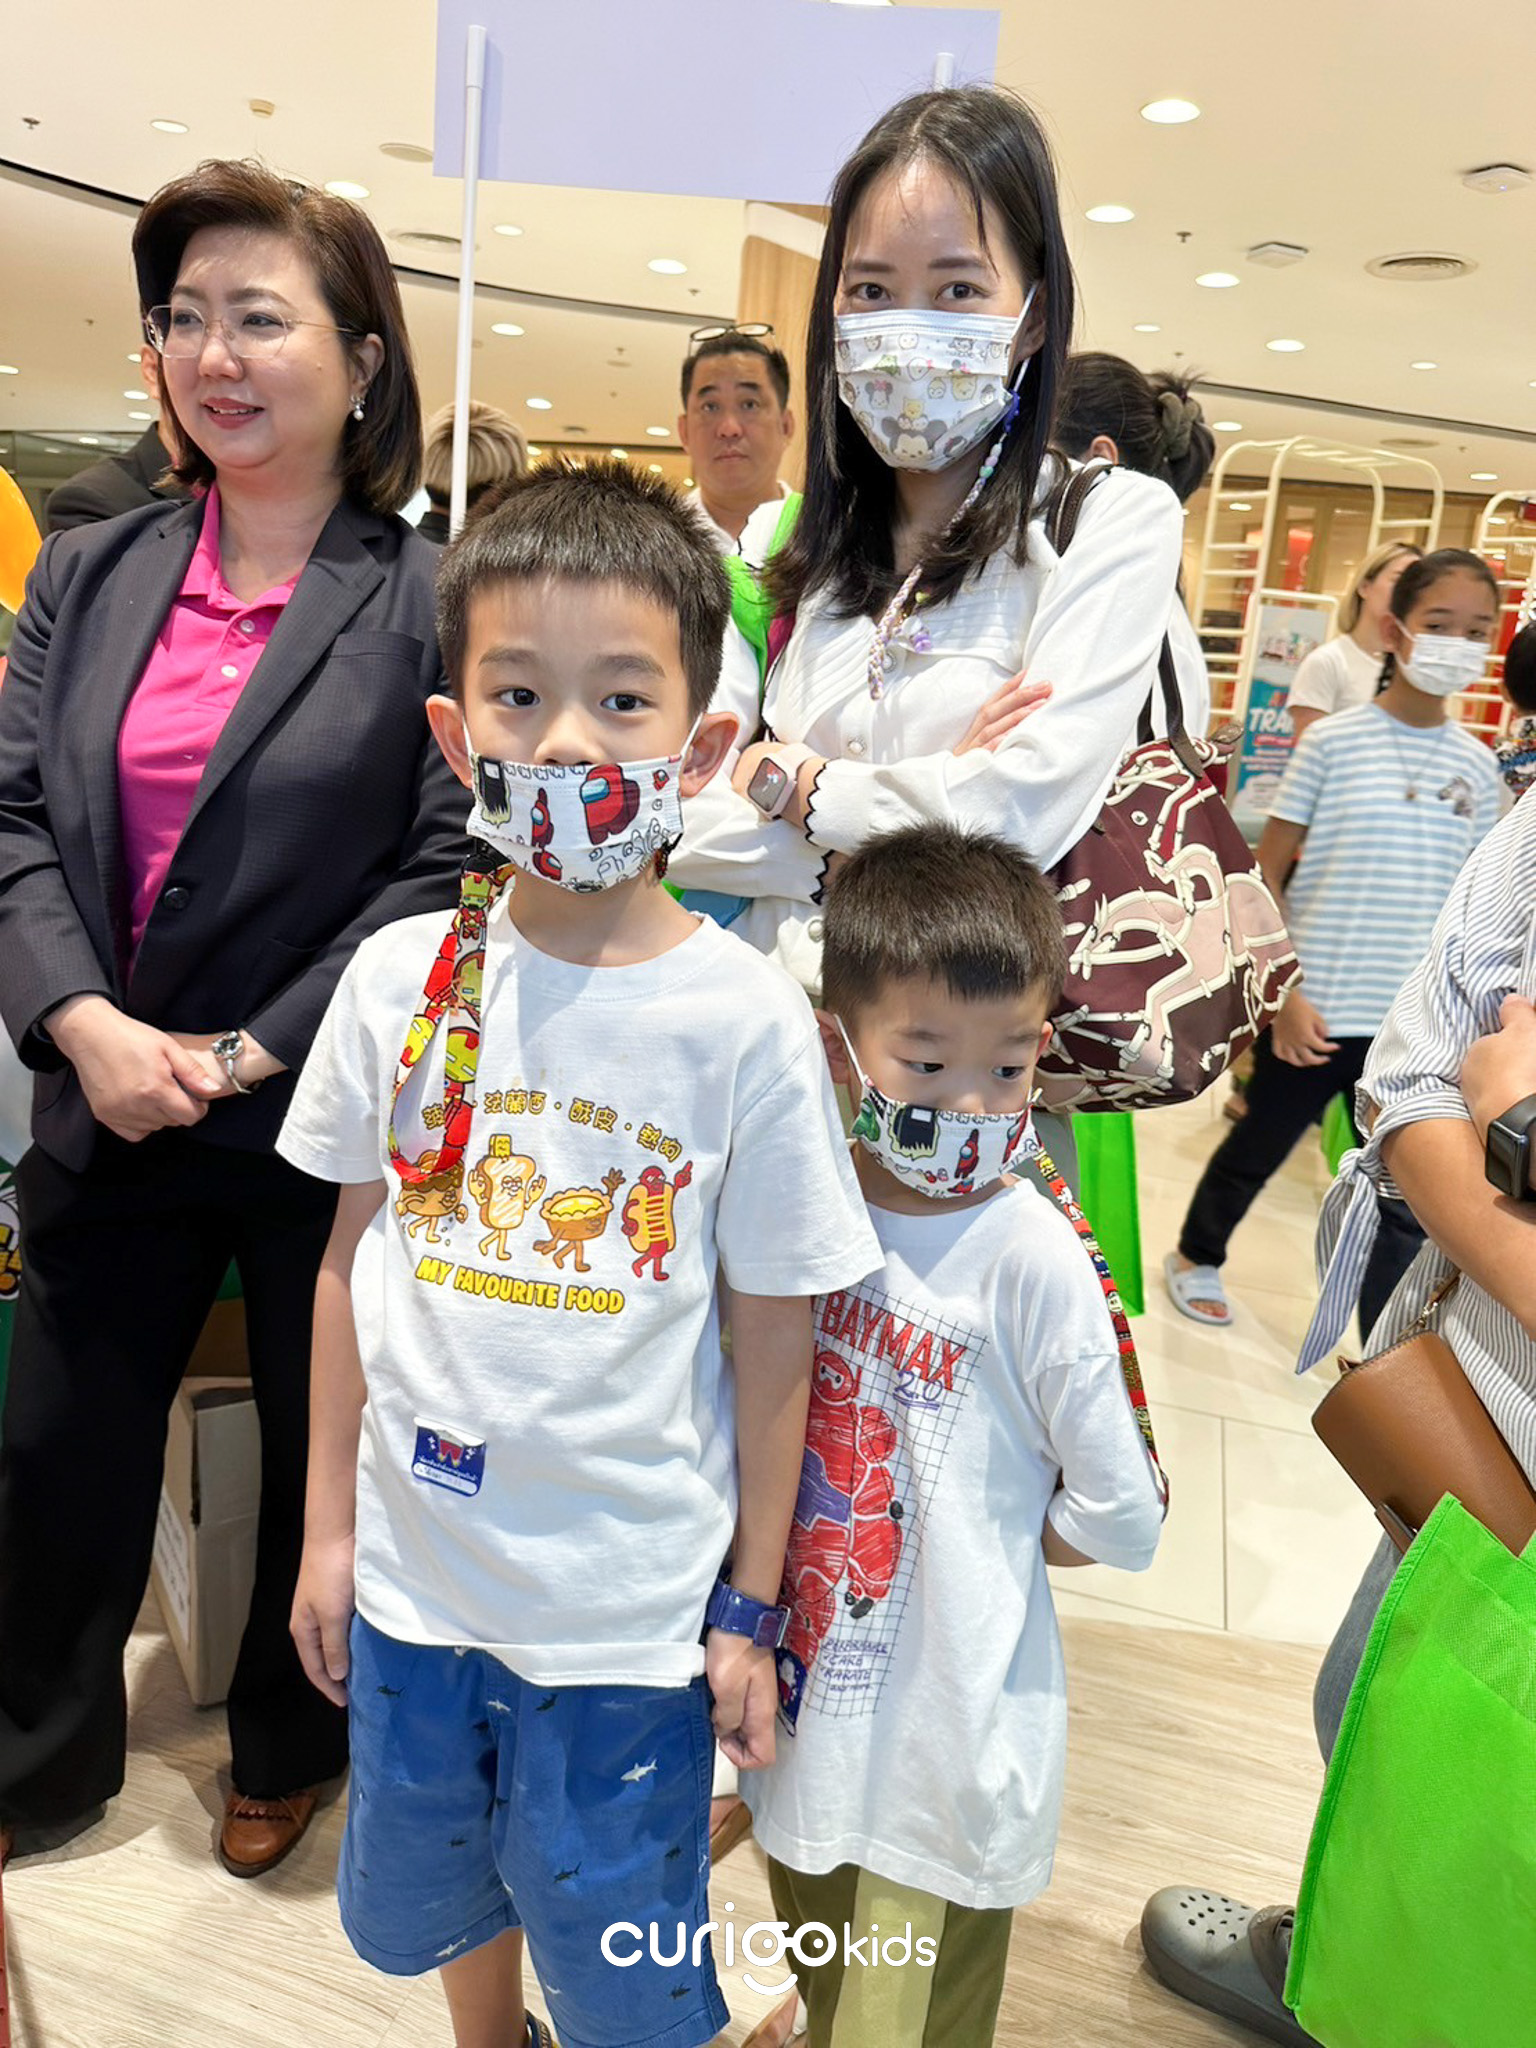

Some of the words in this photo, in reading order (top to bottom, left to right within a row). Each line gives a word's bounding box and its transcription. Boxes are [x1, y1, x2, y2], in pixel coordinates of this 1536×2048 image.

[415, 1255, 454, 1285] MY
[453, 1265, 561, 1308] FAVOURITE
[564, 1284, 625, 1314] FOOD
[821, 1289, 968, 1391] BAYMAX
[894, 1370, 943, 1402] 2.0
